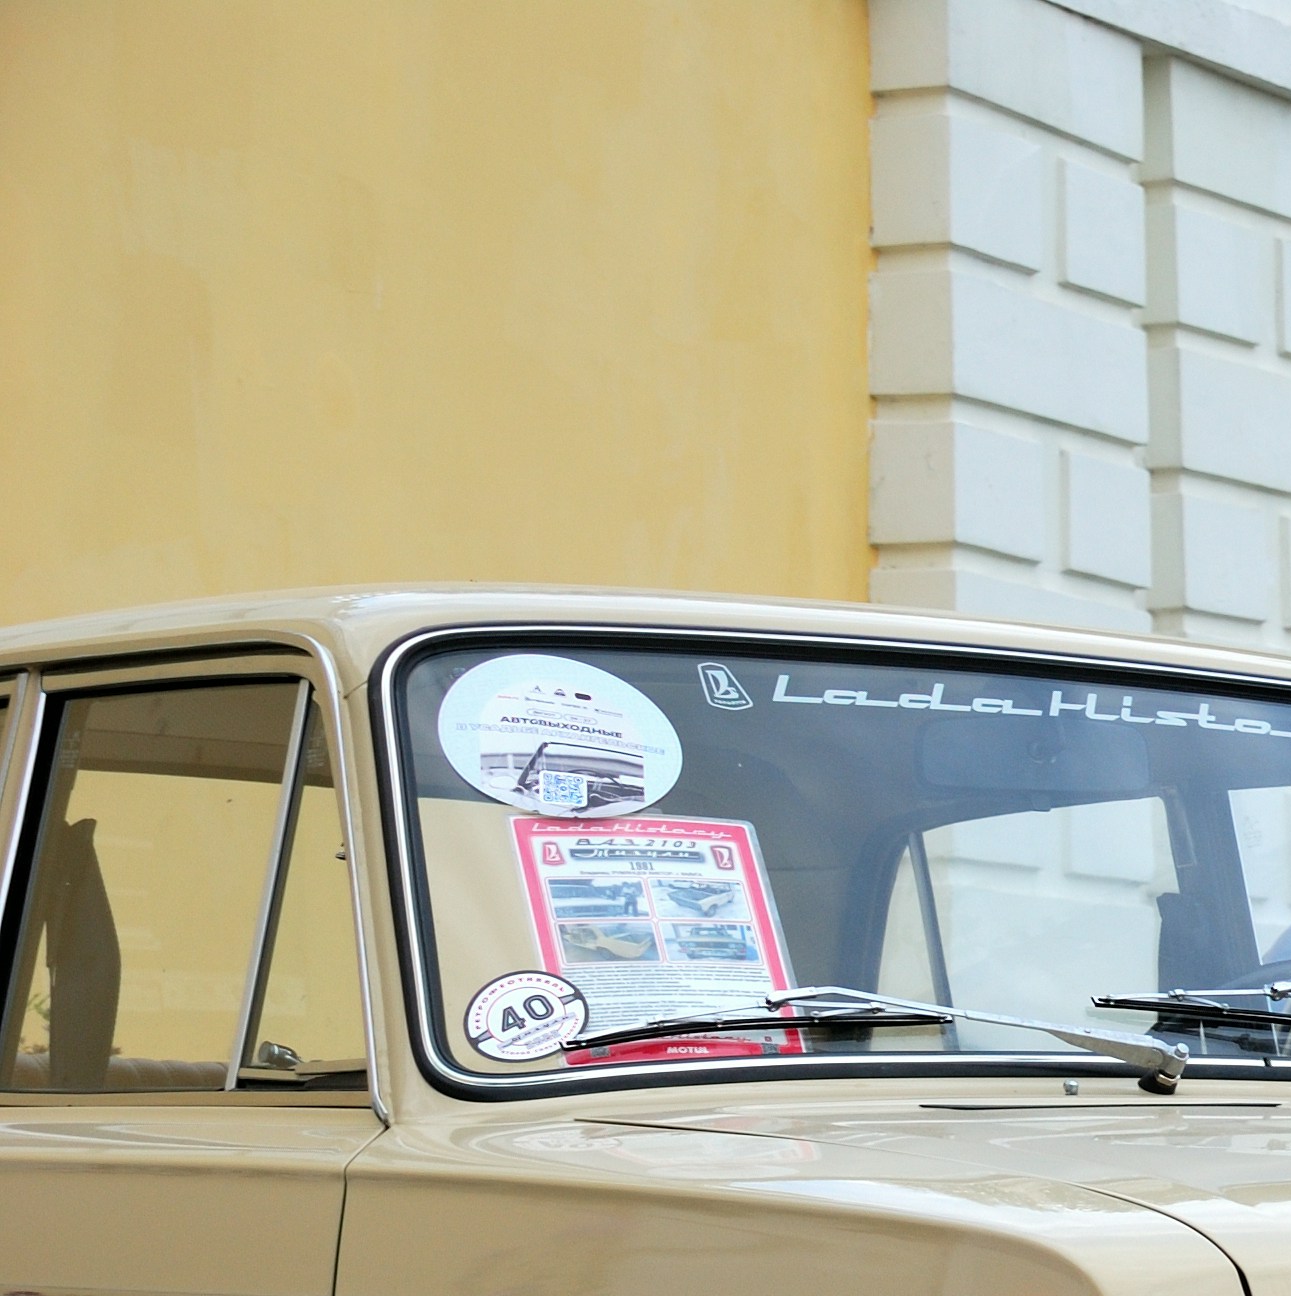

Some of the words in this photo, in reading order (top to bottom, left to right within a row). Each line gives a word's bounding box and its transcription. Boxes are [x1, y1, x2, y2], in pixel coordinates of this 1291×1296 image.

[772, 675, 1043, 716] Lada
[500, 716, 623, 738] АВТОВЫХОДНЫЕ
[532, 822, 611, 832] Lada
[612, 822, 731, 839] History
[645, 839, 698, 849] 2103
[501, 994, 555, 1033] 40
[666, 1046, 710, 1054] MOTUL
